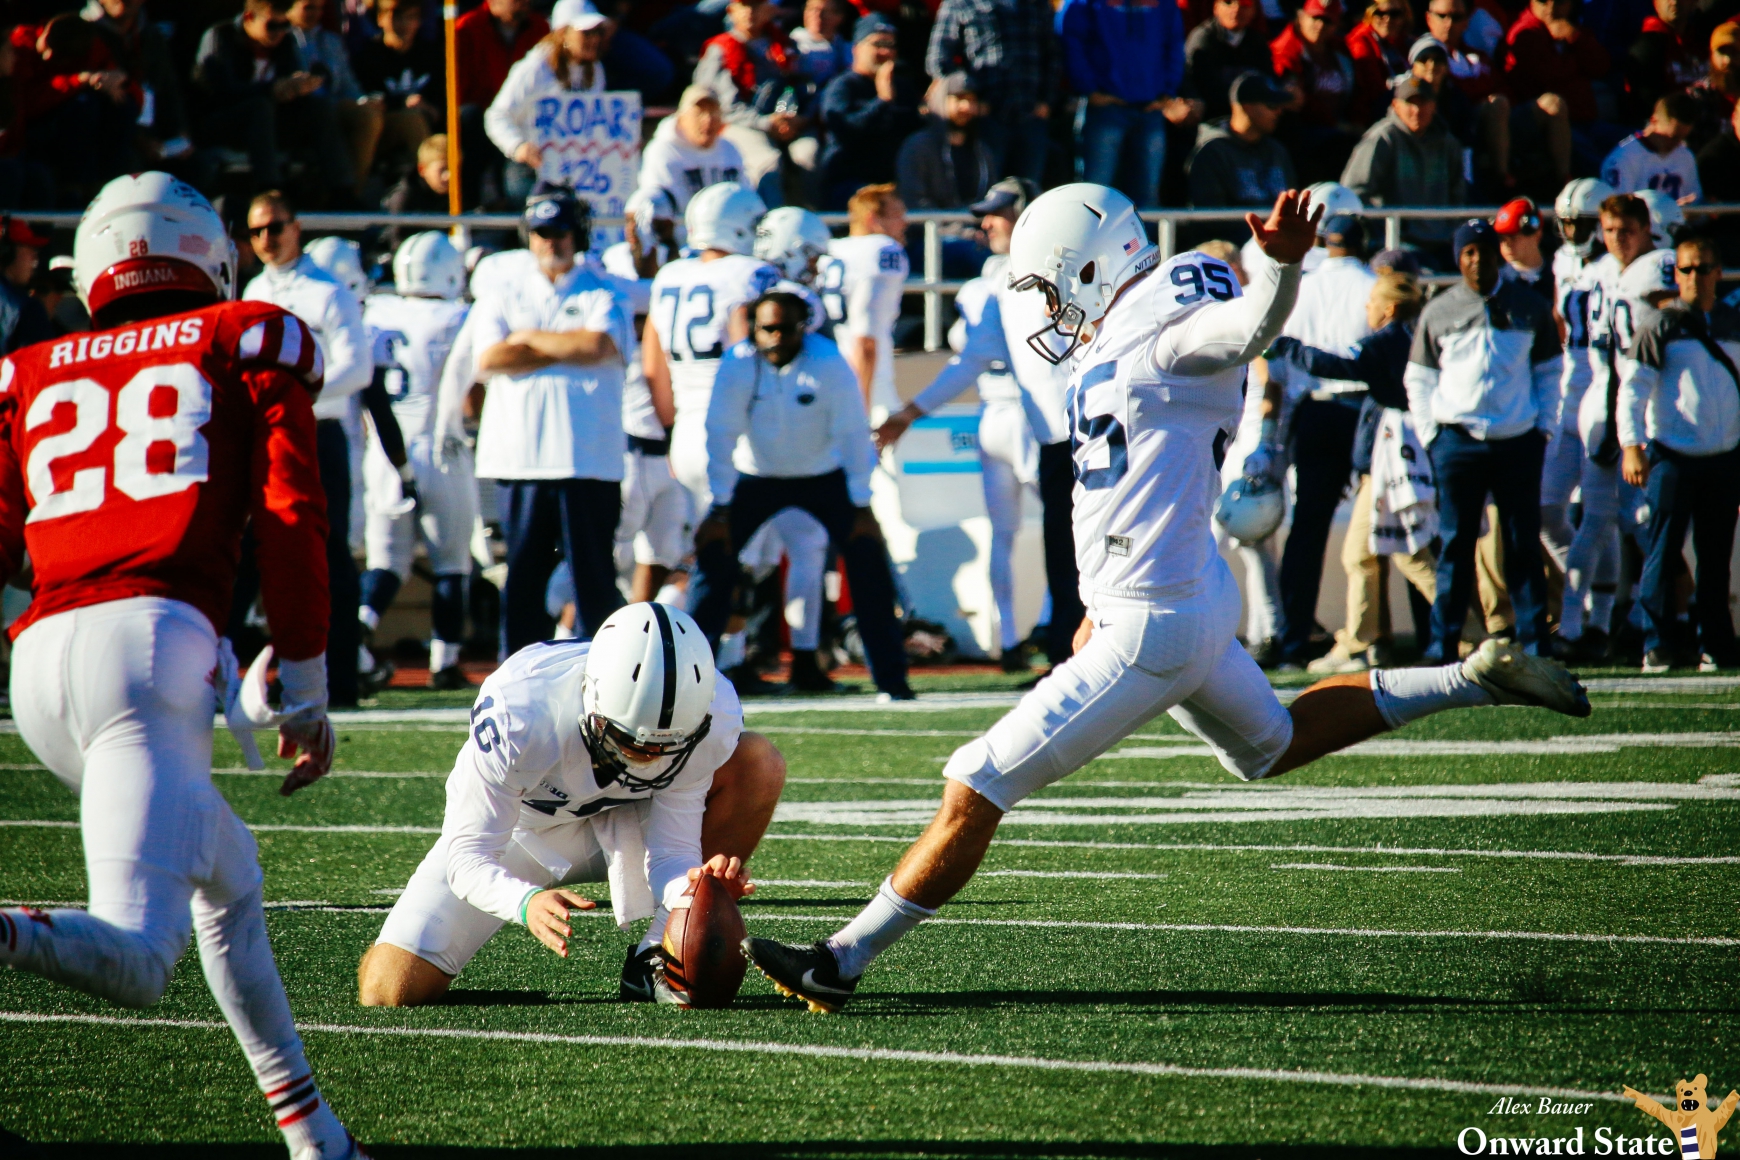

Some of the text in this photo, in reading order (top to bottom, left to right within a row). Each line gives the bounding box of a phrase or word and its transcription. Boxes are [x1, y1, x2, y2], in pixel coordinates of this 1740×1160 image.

[128, 239, 149, 258] 28
[113, 268, 177, 291] INDIANA
[1169, 261, 1235, 306] 95
[49, 317, 204, 370] RIGGINS
[659, 284, 724, 361] 72
[24, 361, 213, 525] 28
